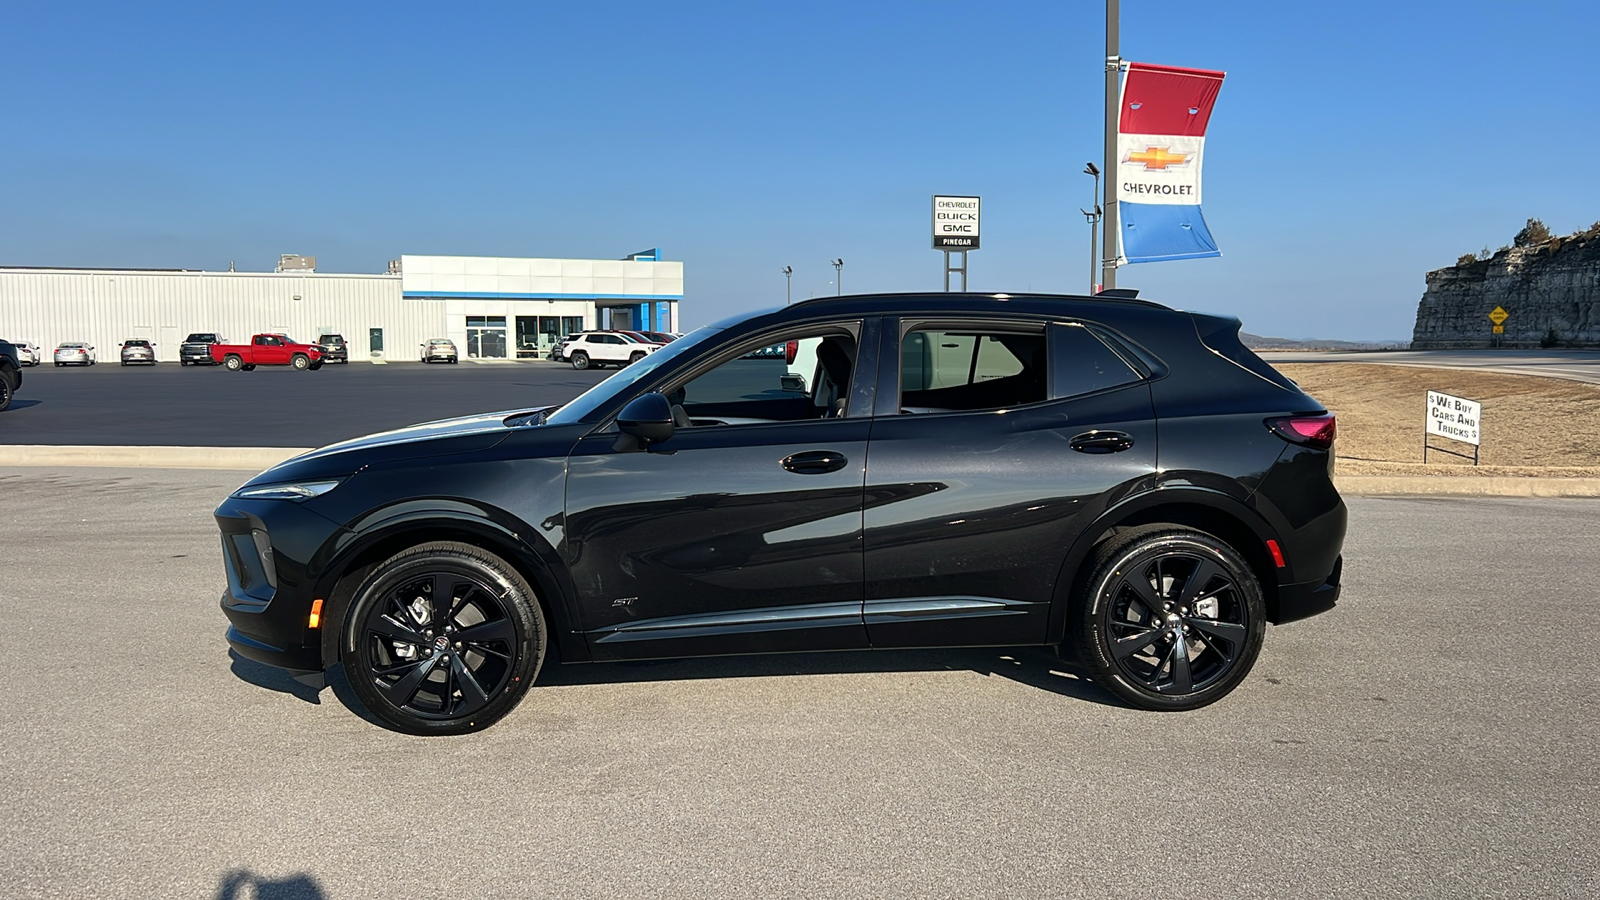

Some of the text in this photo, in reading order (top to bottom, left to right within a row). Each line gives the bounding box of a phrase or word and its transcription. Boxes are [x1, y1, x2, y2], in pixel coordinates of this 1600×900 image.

[1123, 182, 1192, 195] CHEVROLET
[938, 201, 976, 209] CHEVROLET
[937, 212, 977, 220] BUICK
[943, 224, 972, 232] GMC
[942, 238, 972, 246] PINEGAR
[611, 597, 639, 607] ST
